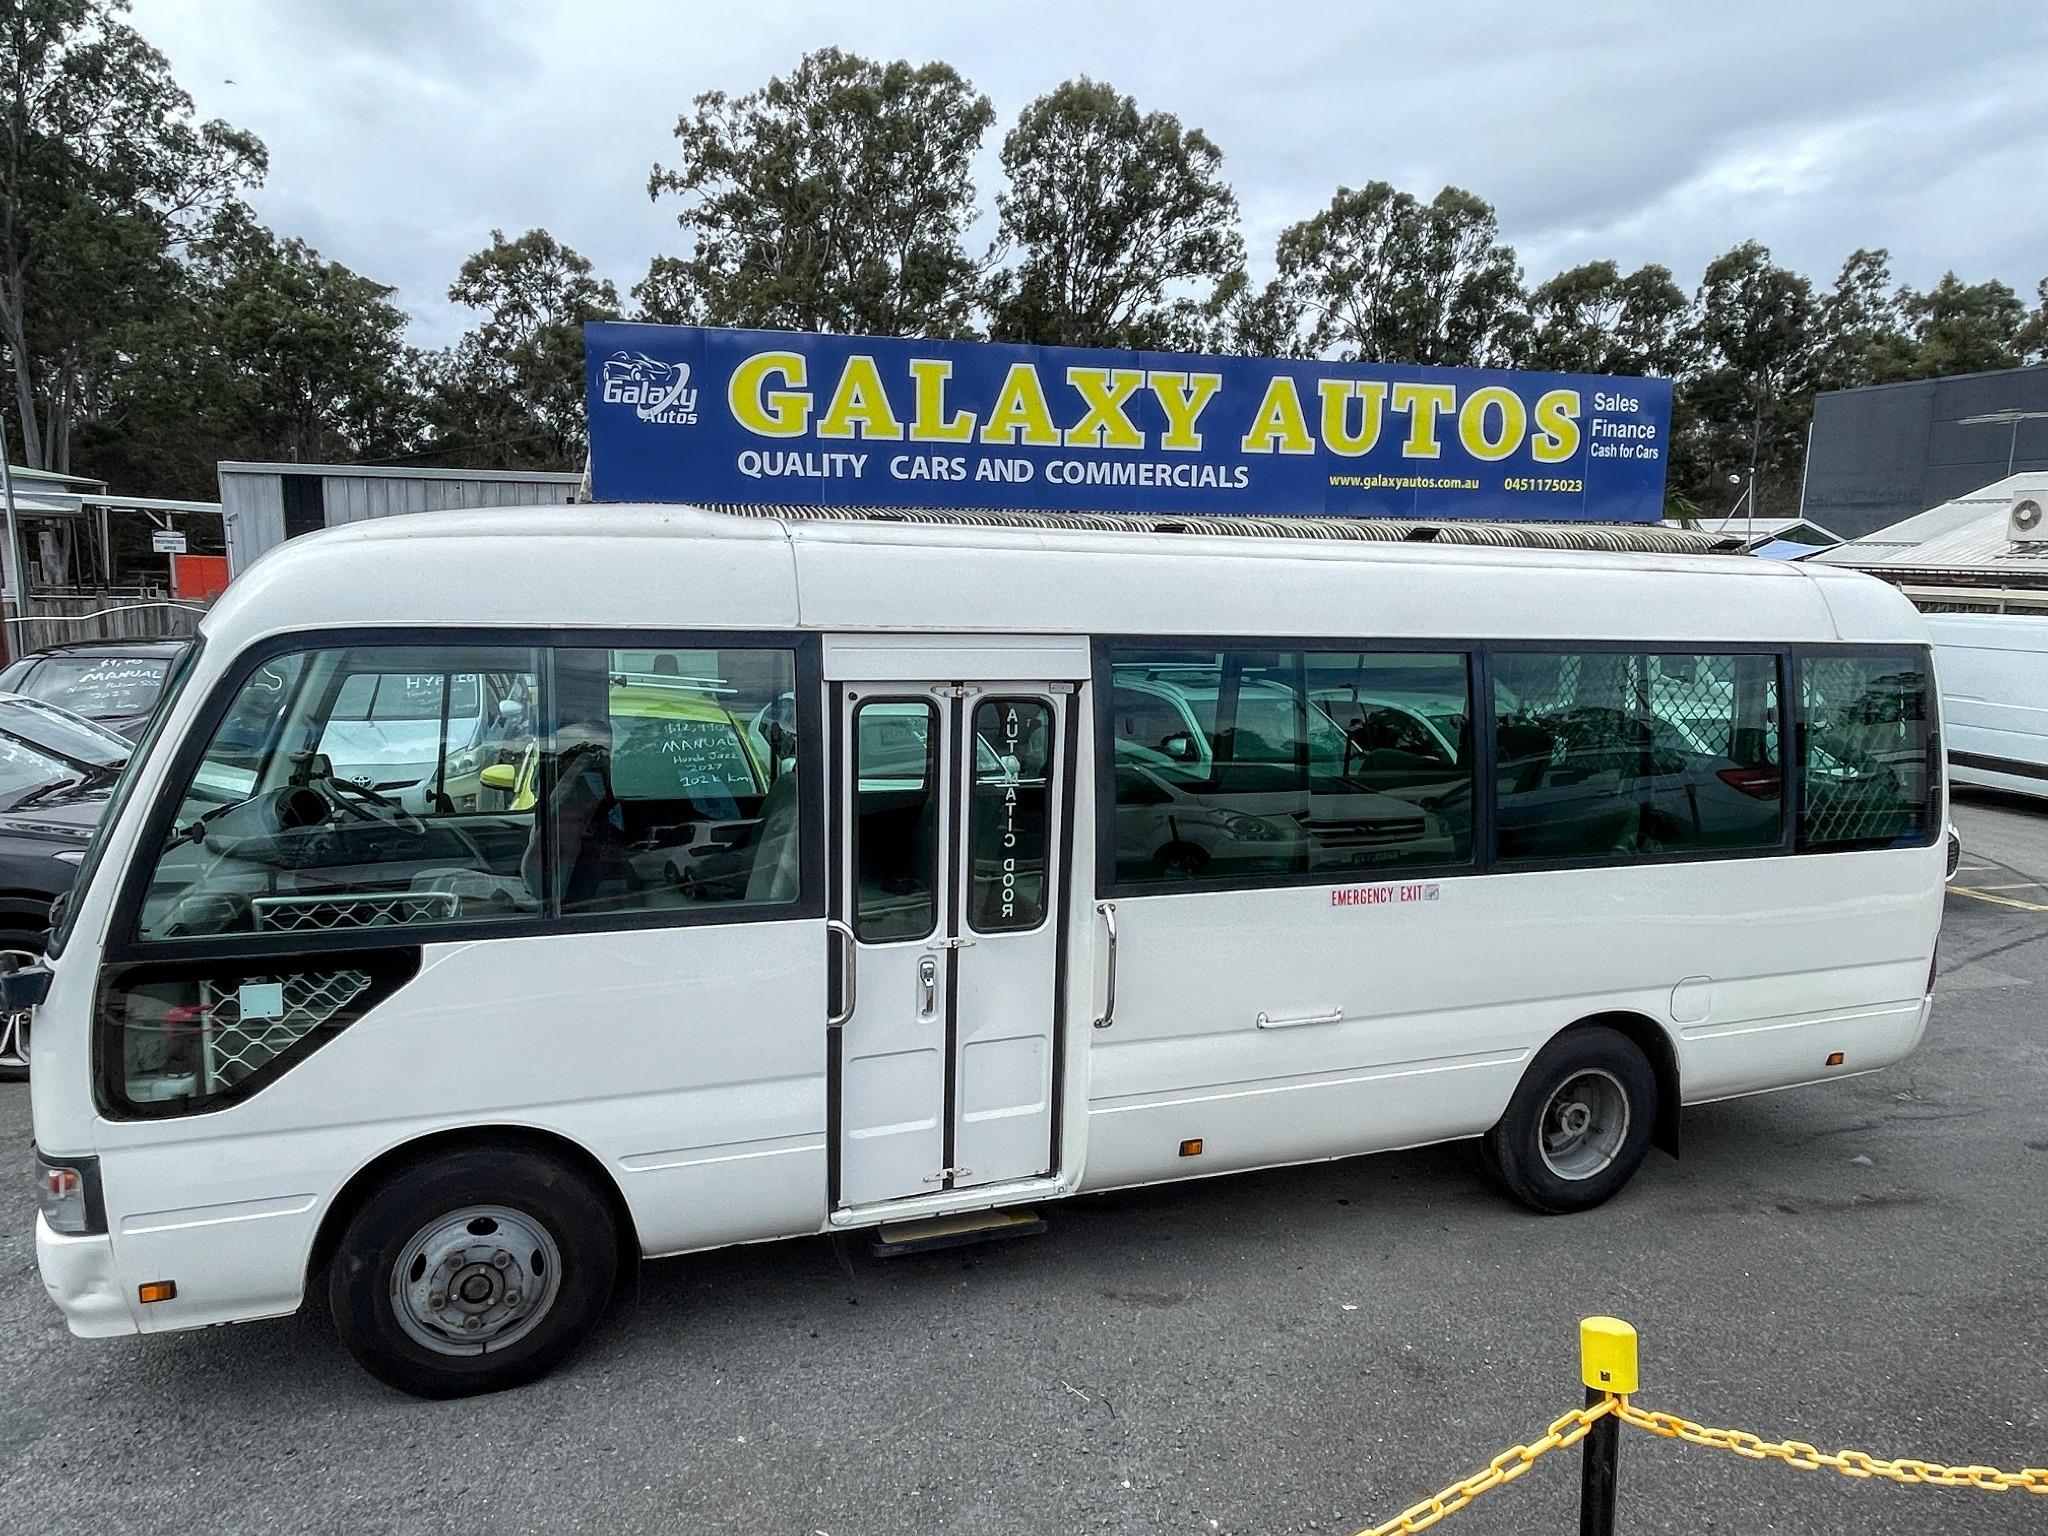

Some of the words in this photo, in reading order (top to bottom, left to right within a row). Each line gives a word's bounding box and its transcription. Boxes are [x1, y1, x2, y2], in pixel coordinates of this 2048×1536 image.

[603, 380, 698, 412] Galaxy
[1594, 392, 1639, 412] Sales
[643, 408, 698, 425] Autos
[728, 351, 1223, 452] GALAXY
[1241, 376, 1581, 464] AUTOS
[1591, 418, 1656, 439] Finance
[1590, 442, 1617, 457] Cash
[1620, 443, 1634, 458] for
[1636, 444, 1659, 459] Cars
[737, 450, 868, 479] QUALITY
[889, 455, 967, 481] CARS
[974, 457, 1034, 483] AND
[1045, 460, 1249, 489] COMMERCIALS
[1329, 474, 1480, 490] www.galaxyautos.com.au
[1504, 478, 1583, 492] 0451175023
[78, 669, 162, 683] MANUAL
[661, 738, 736, 754] MANUAL
[1331, 886, 1394, 907] EMERGENCY
[1400, 884, 1423, 902] EXIT
